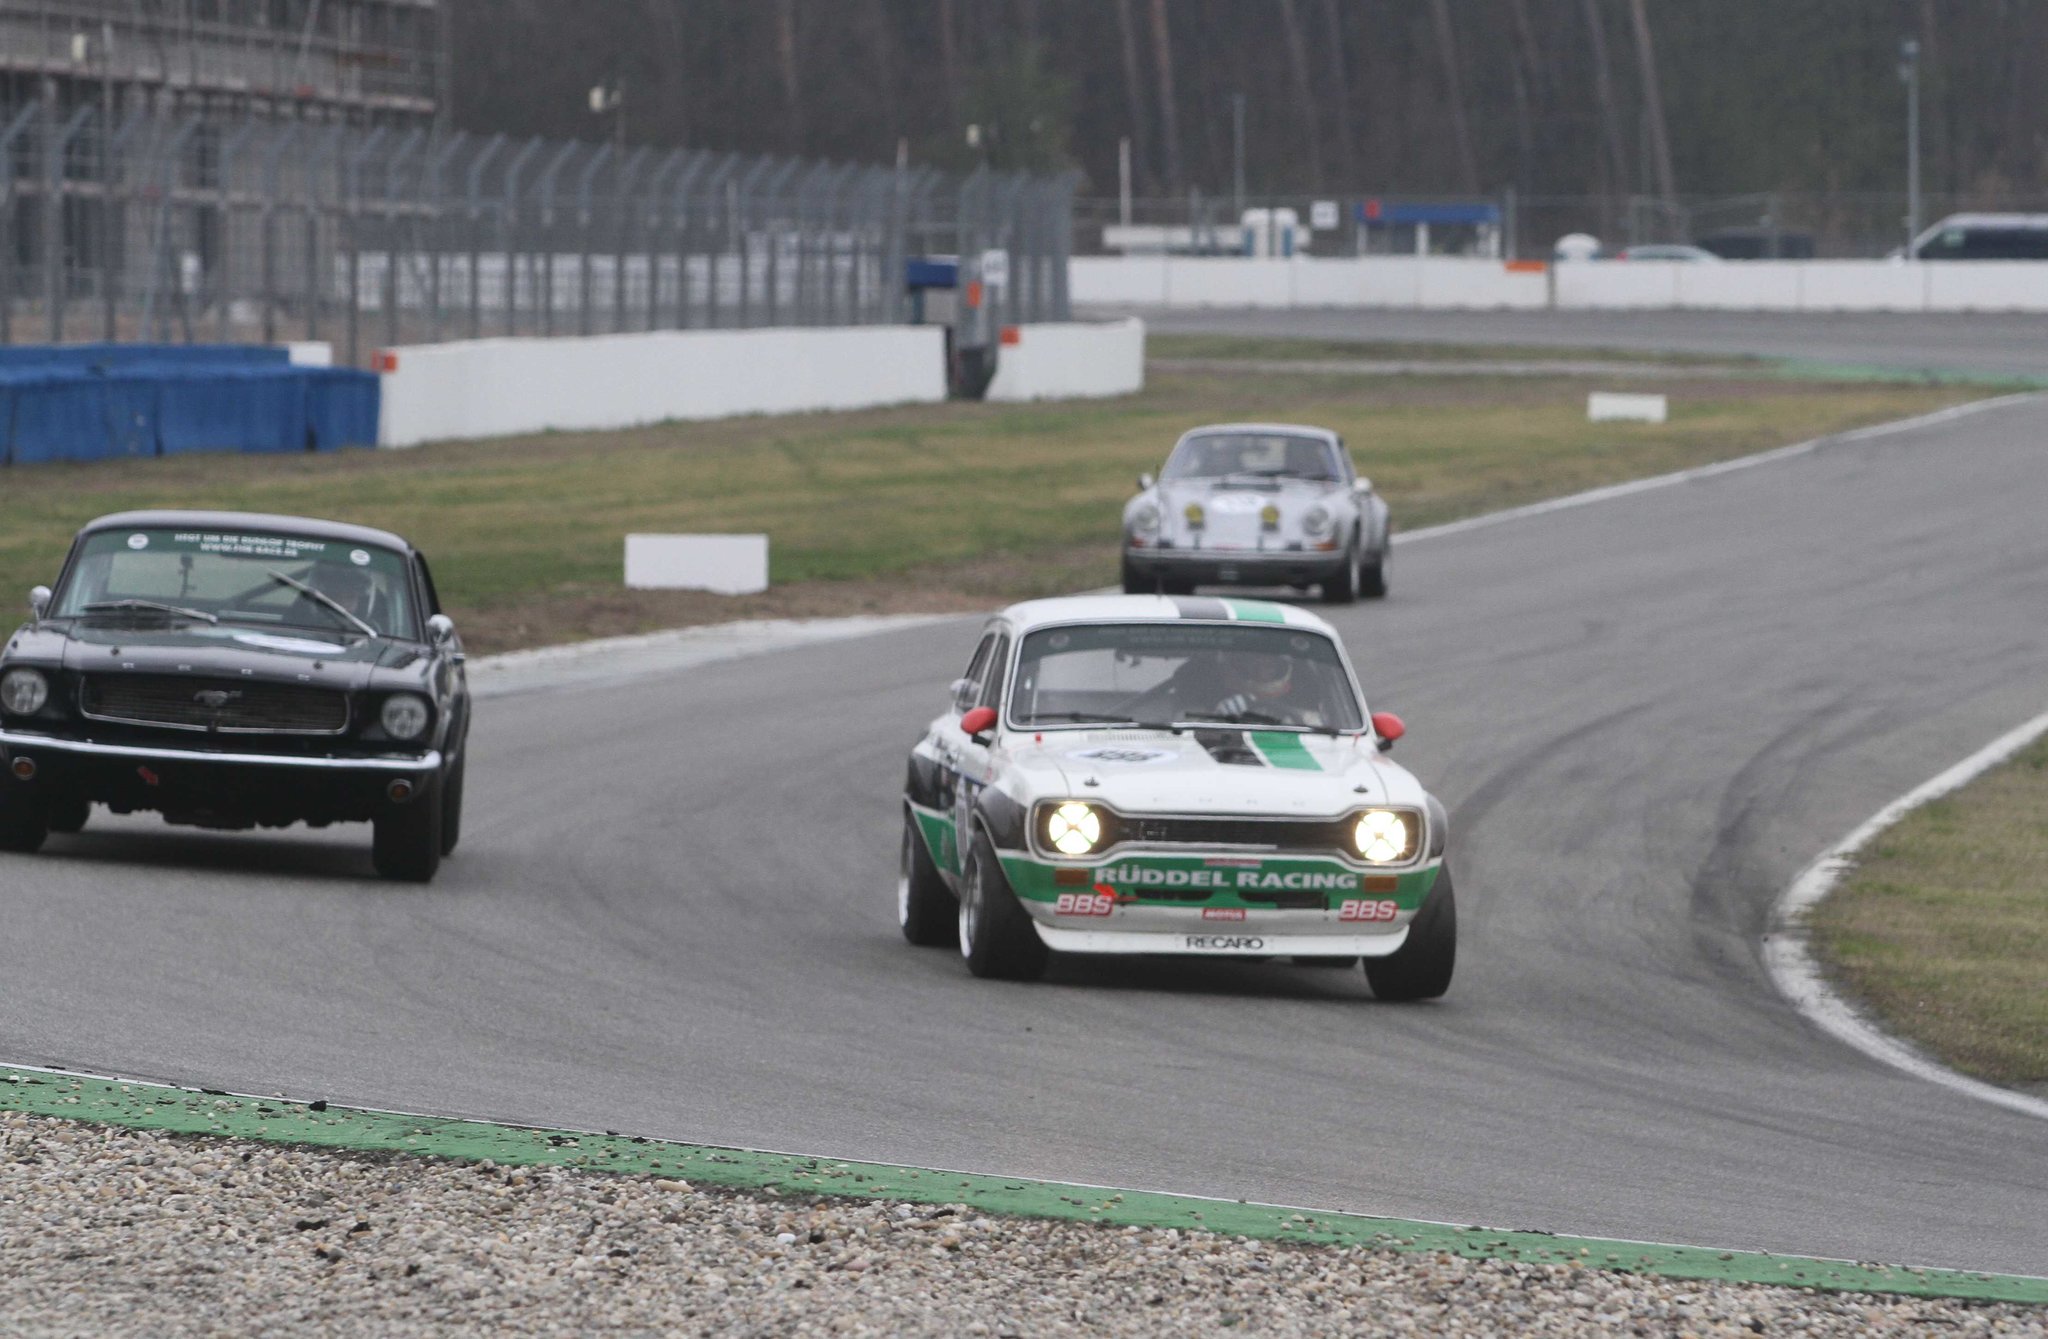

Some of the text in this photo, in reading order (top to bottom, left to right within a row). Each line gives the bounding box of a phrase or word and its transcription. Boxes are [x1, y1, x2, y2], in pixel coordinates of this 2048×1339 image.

[1094, 864, 1358, 890] RÜDDEL RACING
[1055, 893, 1113, 915] BBS
[1340, 900, 1397, 920] BBS
[1185, 935, 1265, 952] RECARO
